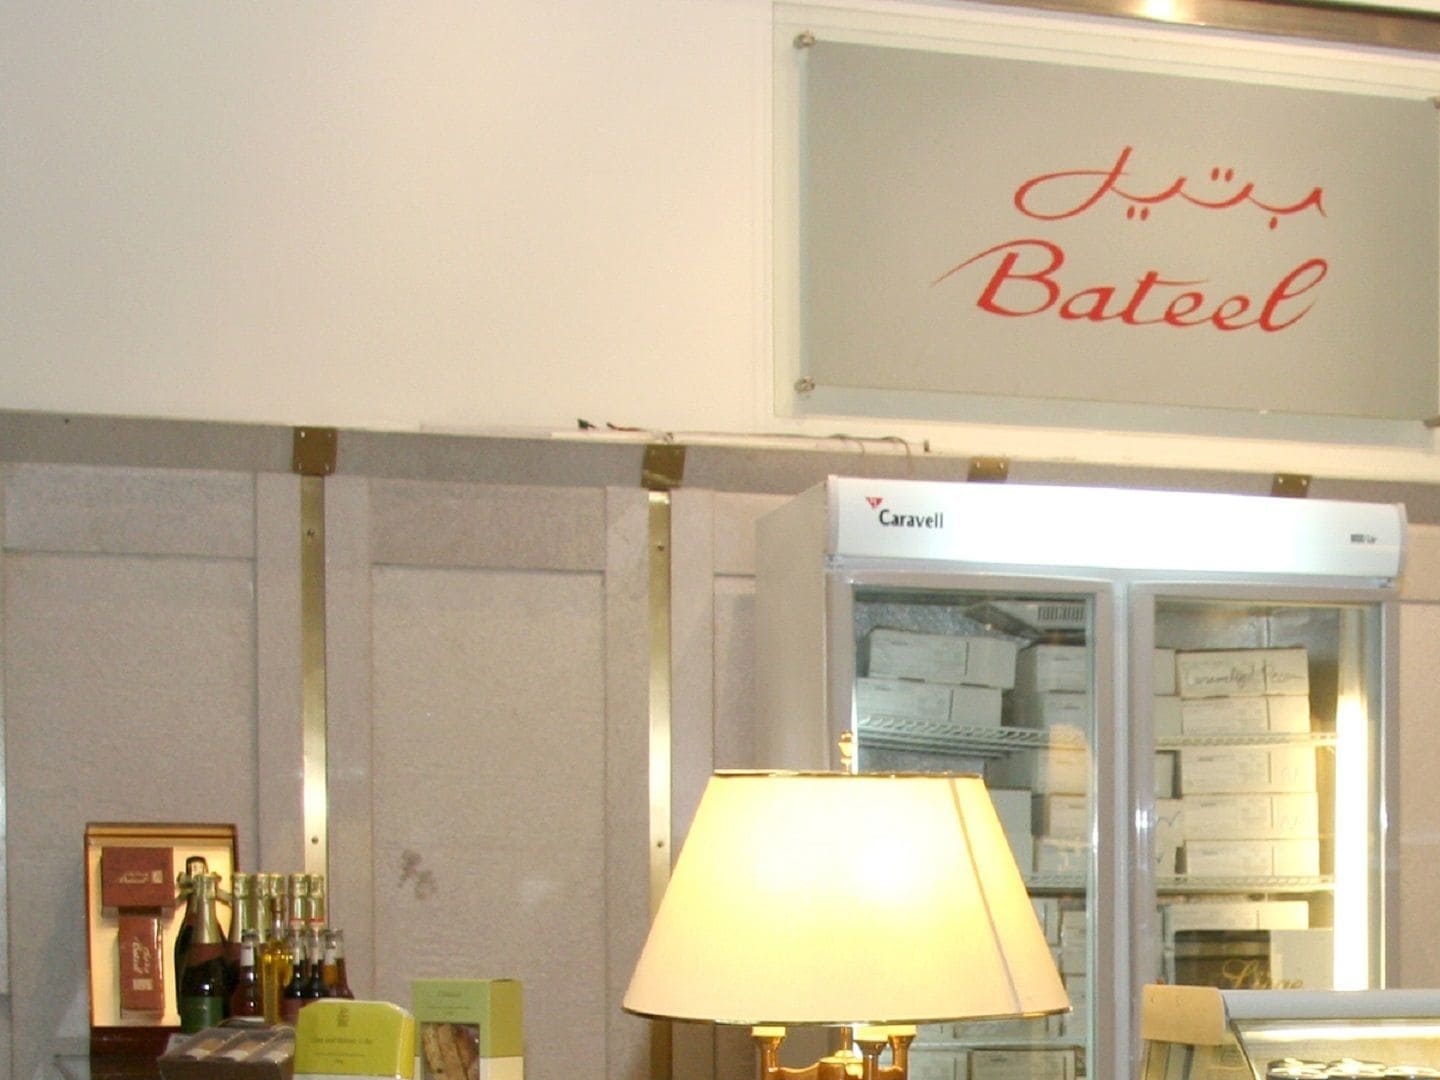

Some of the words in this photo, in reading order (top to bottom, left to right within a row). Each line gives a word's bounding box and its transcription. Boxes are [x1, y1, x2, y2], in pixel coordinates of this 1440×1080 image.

[1013, 145, 1328, 230] بتيل
[929, 238, 1329, 333] Bateel
[878, 508, 944, 529] Caravell
